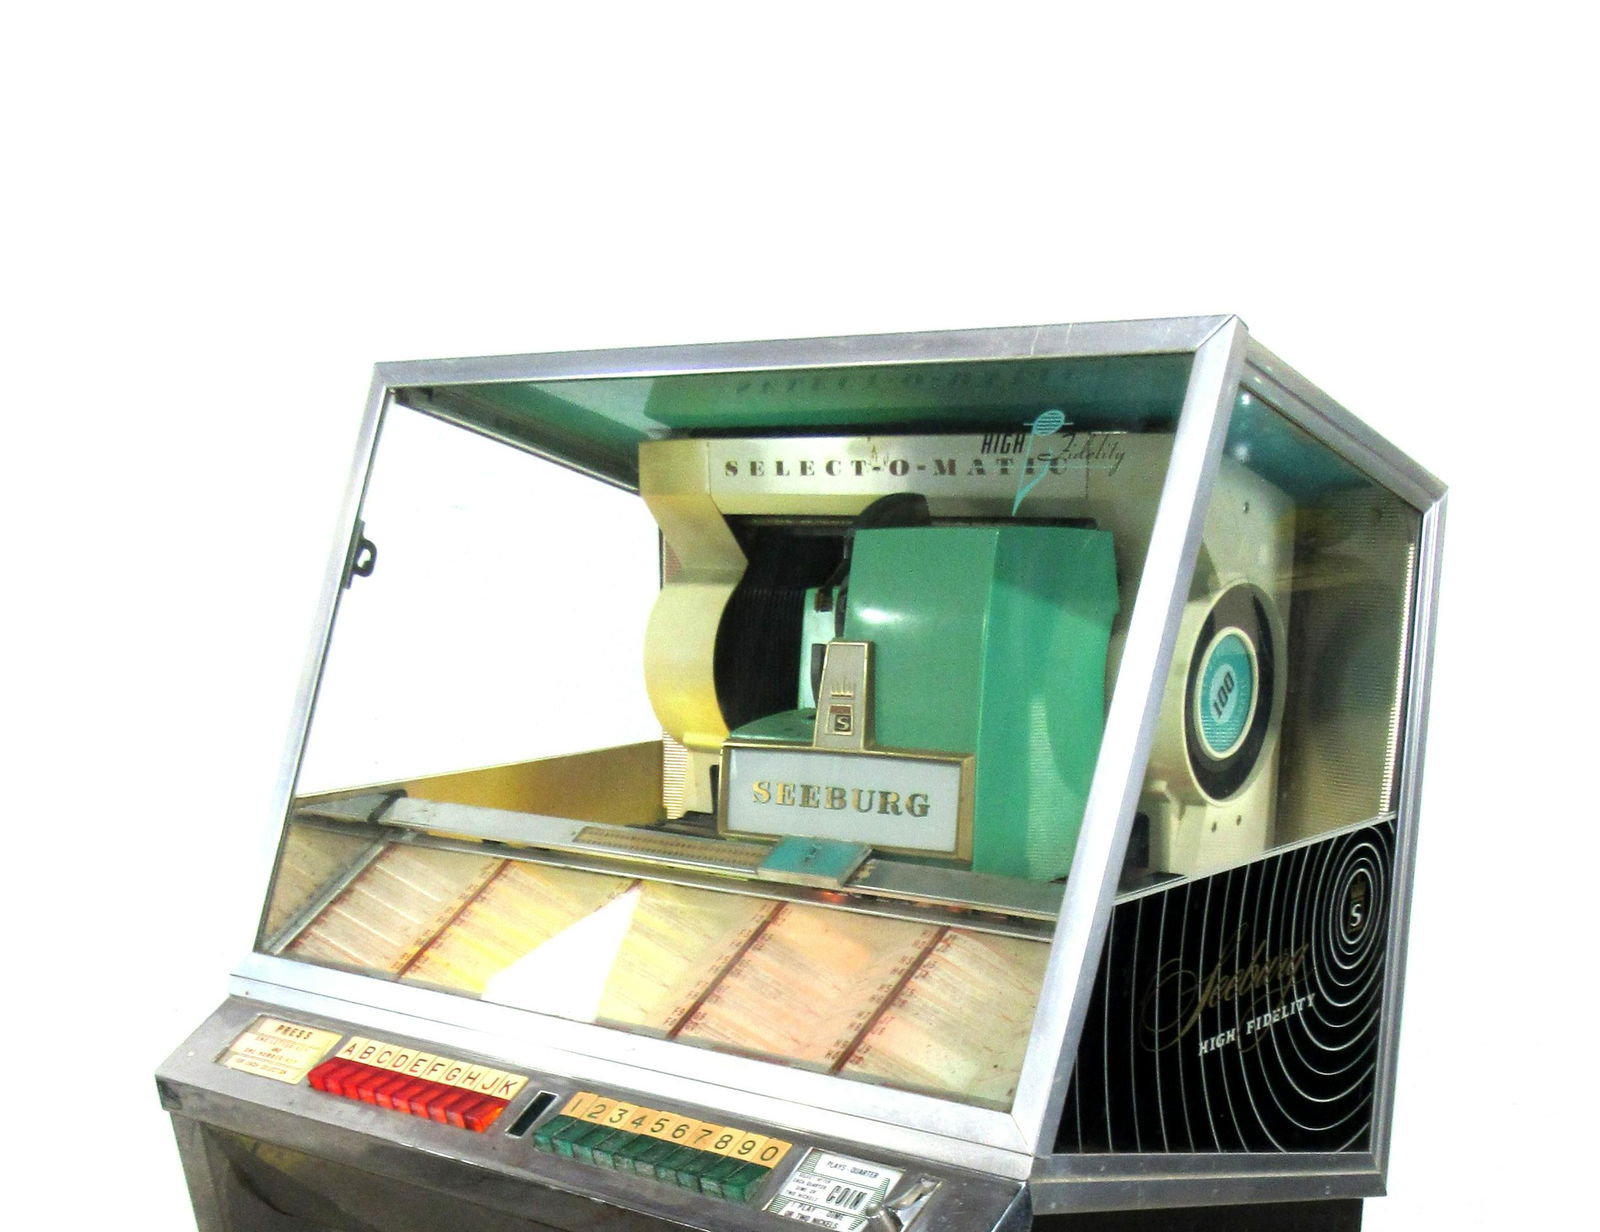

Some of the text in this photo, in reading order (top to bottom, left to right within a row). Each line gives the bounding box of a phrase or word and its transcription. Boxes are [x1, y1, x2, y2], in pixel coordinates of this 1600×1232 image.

[981, 431, 1026, 454] HIGH
[724, 456, 1068, 478] SELECT-O-MATIC
[1212, 671, 1235, 720] 100
[835, 715, 851, 732] S
[752, 780, 931, 818] SEEBURG
[1349, 902, 1363, 927] S
[274, 1024, 313, 1040] PRESS
[1198, 992, 1317, 1057] HIGH FIDELITY
[827, 1160, 880, 1179] PLAYS QUARTER
[799, 1201, 818, 1213] PLAY
[825, 1185, 869, 1211] COIN
